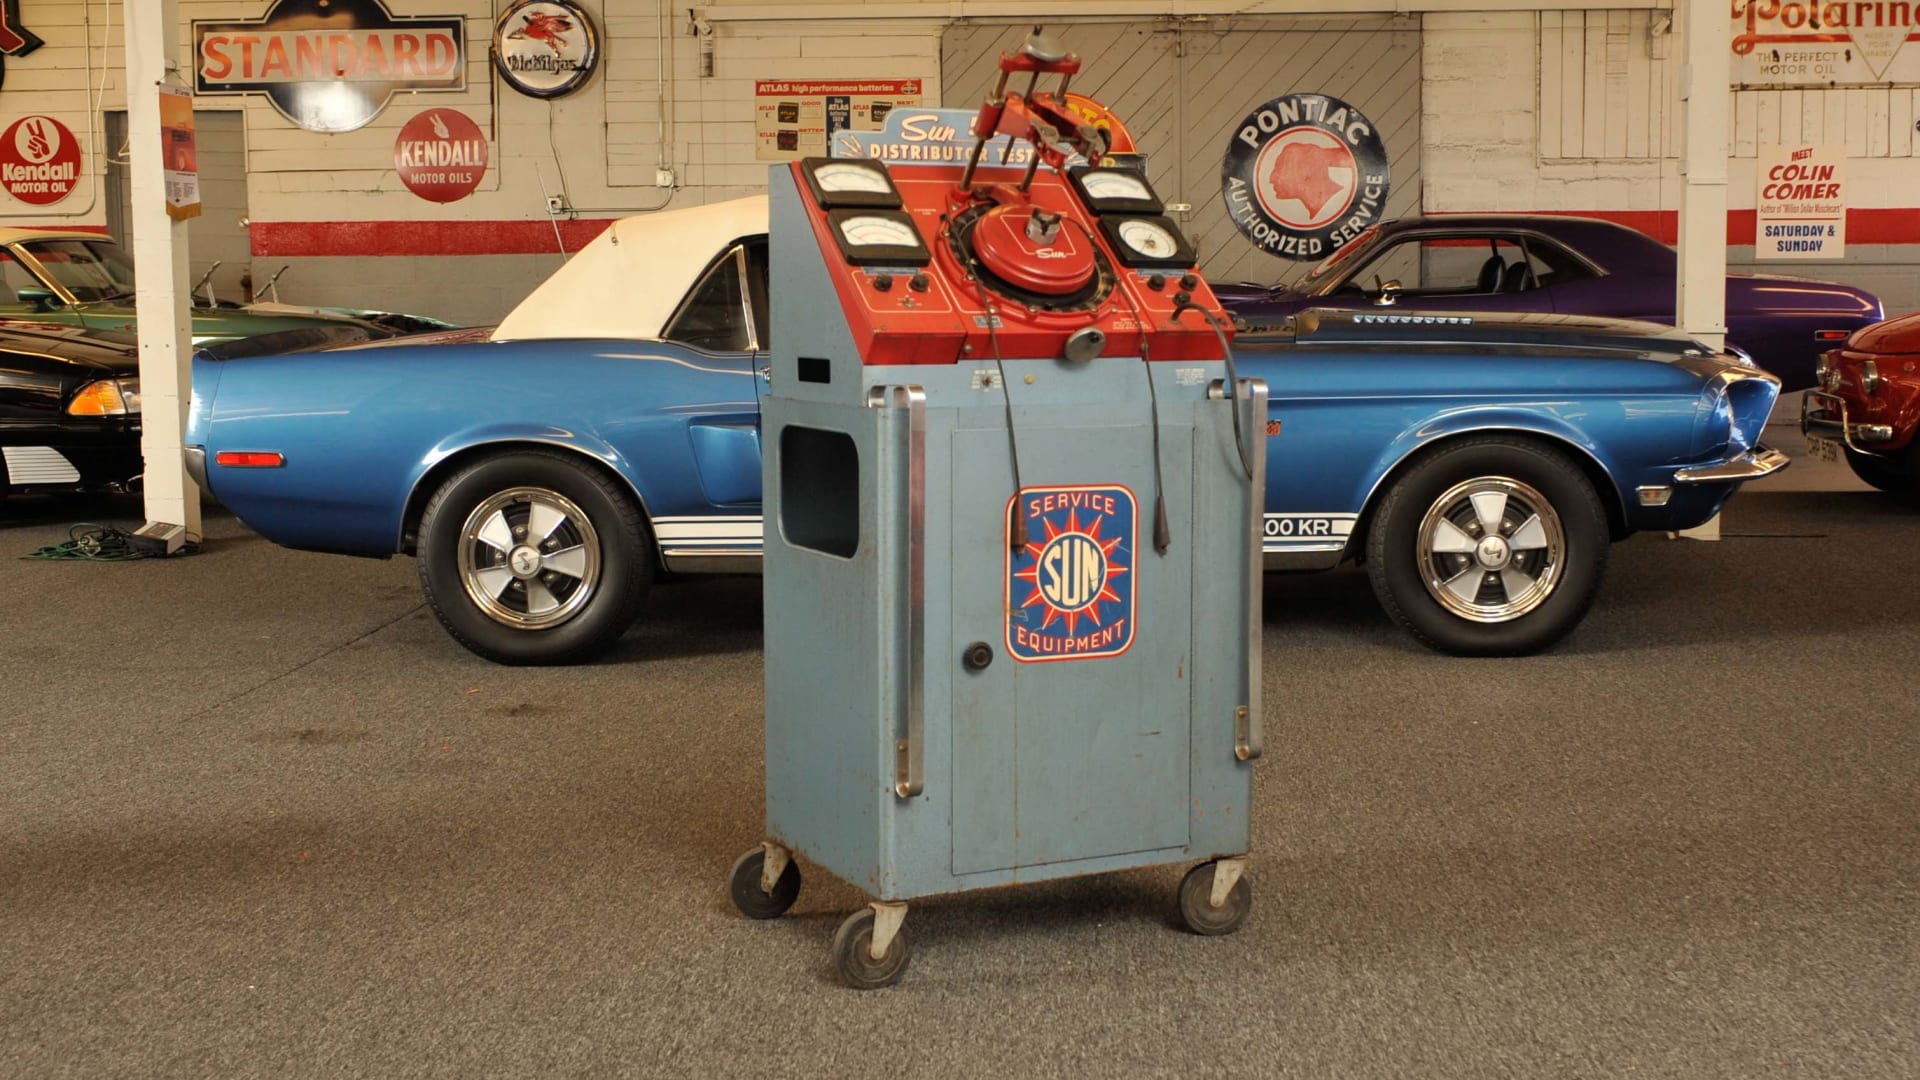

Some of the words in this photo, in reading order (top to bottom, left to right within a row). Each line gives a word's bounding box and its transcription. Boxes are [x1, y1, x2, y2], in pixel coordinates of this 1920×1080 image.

[1731, 0, 1920, 55] Polarin
[204, 33, 456, 79] STANDARD
[1785, 52, 1838, 62] PERFECT
[1760, 65, 1806, 75] MOTOR
[1814, 65, 1836, 74] OIL
[759, 84, 789, 92] ATLAS
[792, 84, 808, 94] high
[809, 85, 857, 94] performance
[859, 84, 894, 92] batteries
[901, 115, 955, 141] Sun
[1239, 98, 1370, 149] PONTIAC
[401, 140, 484, 167] KENDALL
[1791, 148, 1813, 161] MEET
[2, 162, 74, 181] Kendall
[410, 173, 446, 184] MOTOR
[449, 173, 472, 184] OILS
[1769, 164, 1834, 181] COLIN
[11, 182, 48, 193] MOTOR
[51, 182, 68, 192] OIL
[1762, 183, 1841, 200] COMER
[1229, 176, 1322, 255] AUTHORIZED
[1330, 175, 1383, 248] SERVICE
[1765, 225, 1824, 237] SATURDAY
[1827, 225, 1835, 236] &
[1036, 248, 1067, 259] Sun
[1777, 240, 1822, 252] SUNDAY
[1030, 493, 1116, 518] SERVICE
[1263, 519, 1294, 535] 00
[1298, 519, 1330, 535] KR
[1044, 538, 1100, 606] SUN
[1017, 618, 1125, 653] EQUIPMENT
